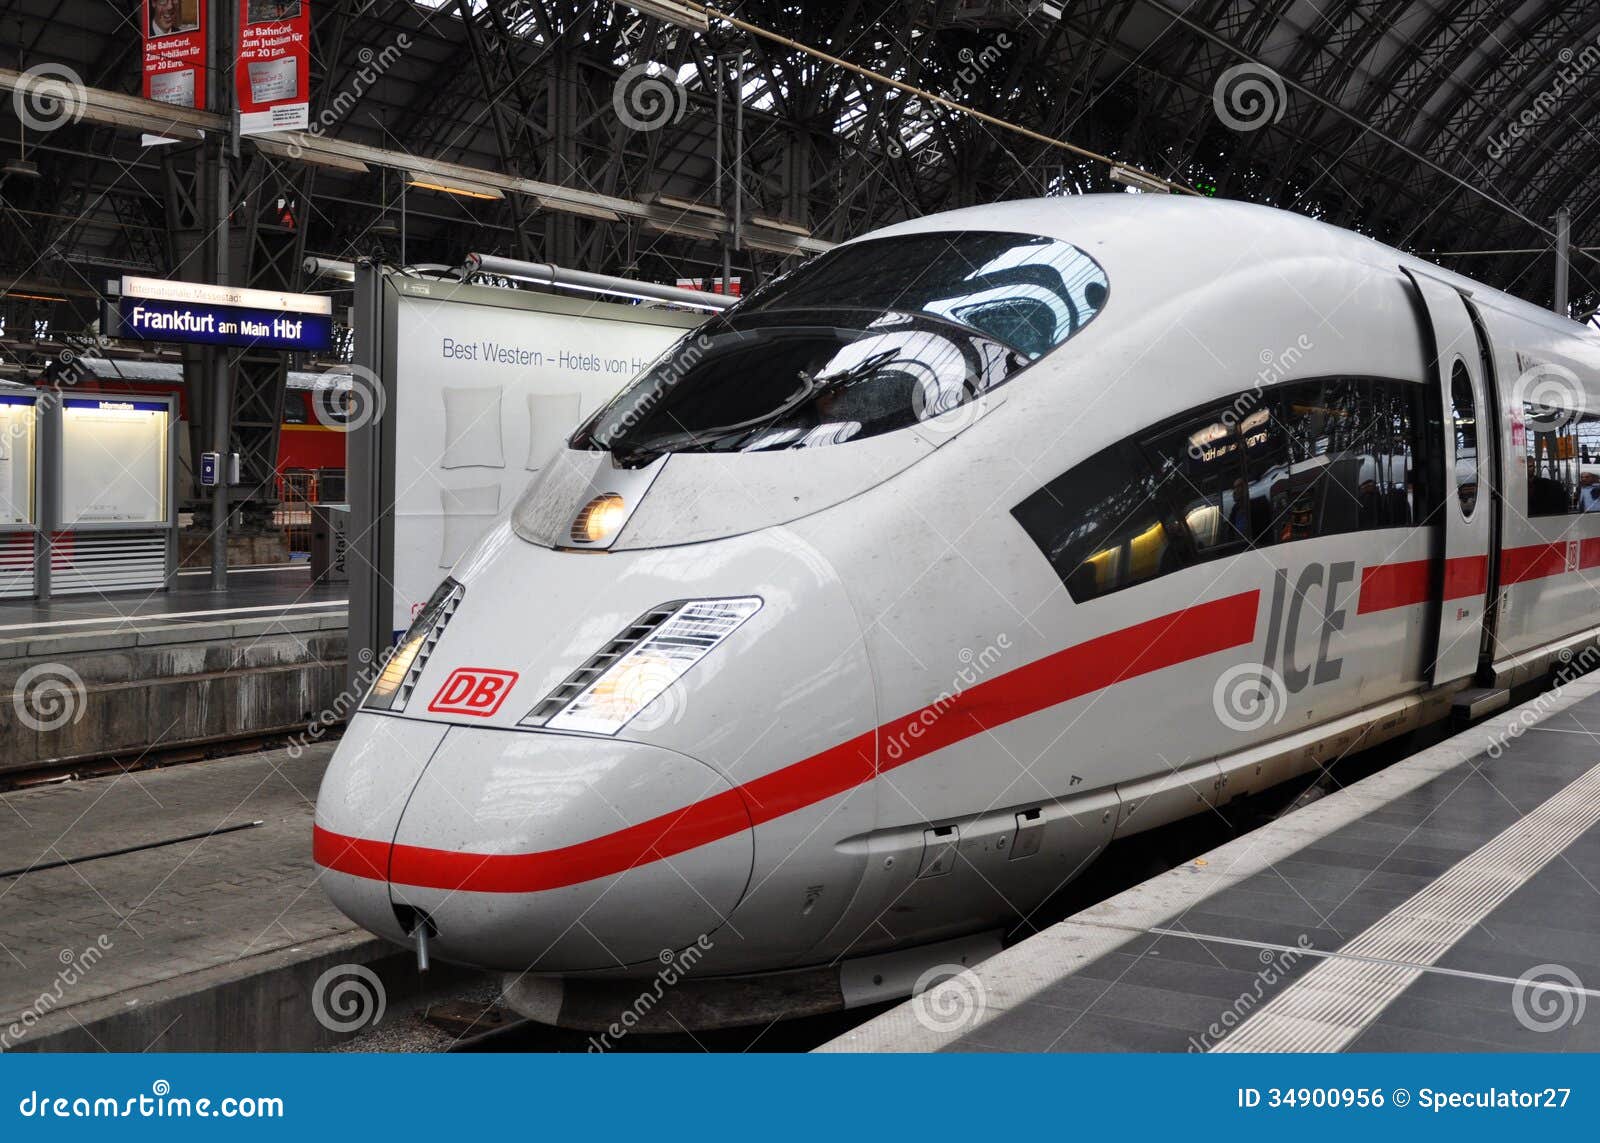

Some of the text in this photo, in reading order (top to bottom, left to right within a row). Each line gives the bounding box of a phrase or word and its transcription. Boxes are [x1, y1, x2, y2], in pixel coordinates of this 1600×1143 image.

[146, 43, 156, 51] Die
[190, 46, 200, 55] für
[242, 39, 260, 47] Zum
[292, 32, 303, 41] für
[157, 61, 167, 69] 20
[133, 307, 302, 339] Frankfurt am Main Hbf
[442, 338, 477, 360] Best
[482, 342, 542, 366] Western
[559, 350, 600, 372] Hotels
[604, 359, 627, 373] von
[1257, 561, 1355, 702] ICE
[439, 674, 505, 708] DB
